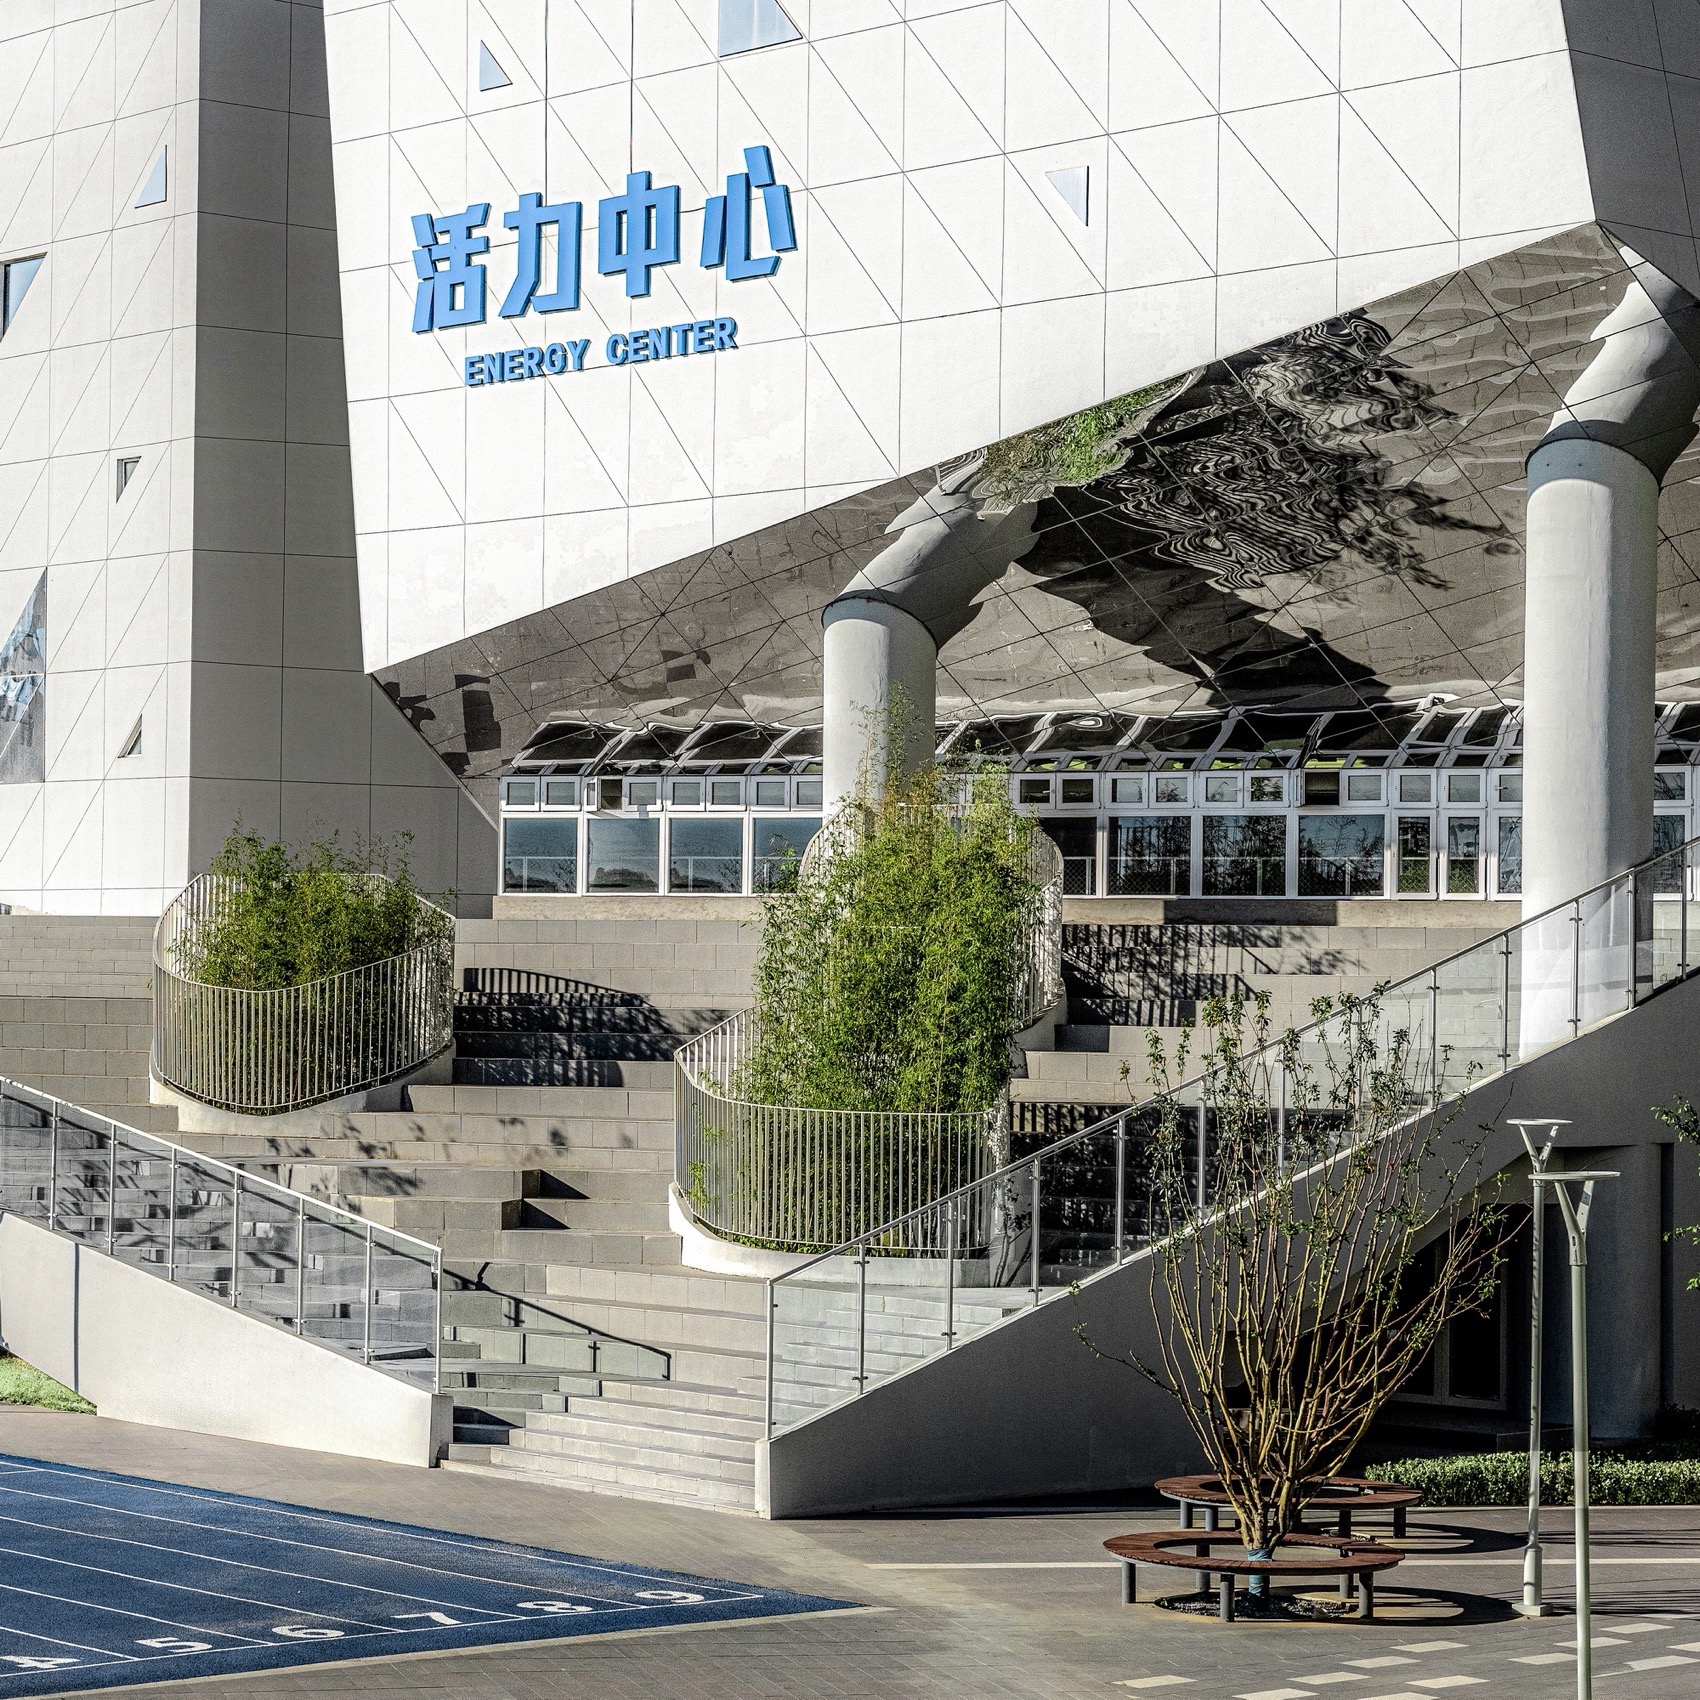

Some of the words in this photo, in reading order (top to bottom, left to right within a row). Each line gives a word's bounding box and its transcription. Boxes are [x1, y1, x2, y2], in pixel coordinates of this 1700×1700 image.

[411, 145, 798, 334] 活力中心
[465, 338, 590, 387] ENERGY
[605, 316, 738, 367] CENTER
[0, 1655, 82, 1669] 4
[135, 1637, 213, 1653] 5
[272, 1625, 345, 1638] 6
[390, 1612, 463, 1625] 7
[516, 1601, 593, 1612] 8
[634, 1590, 705, 1603] 9
